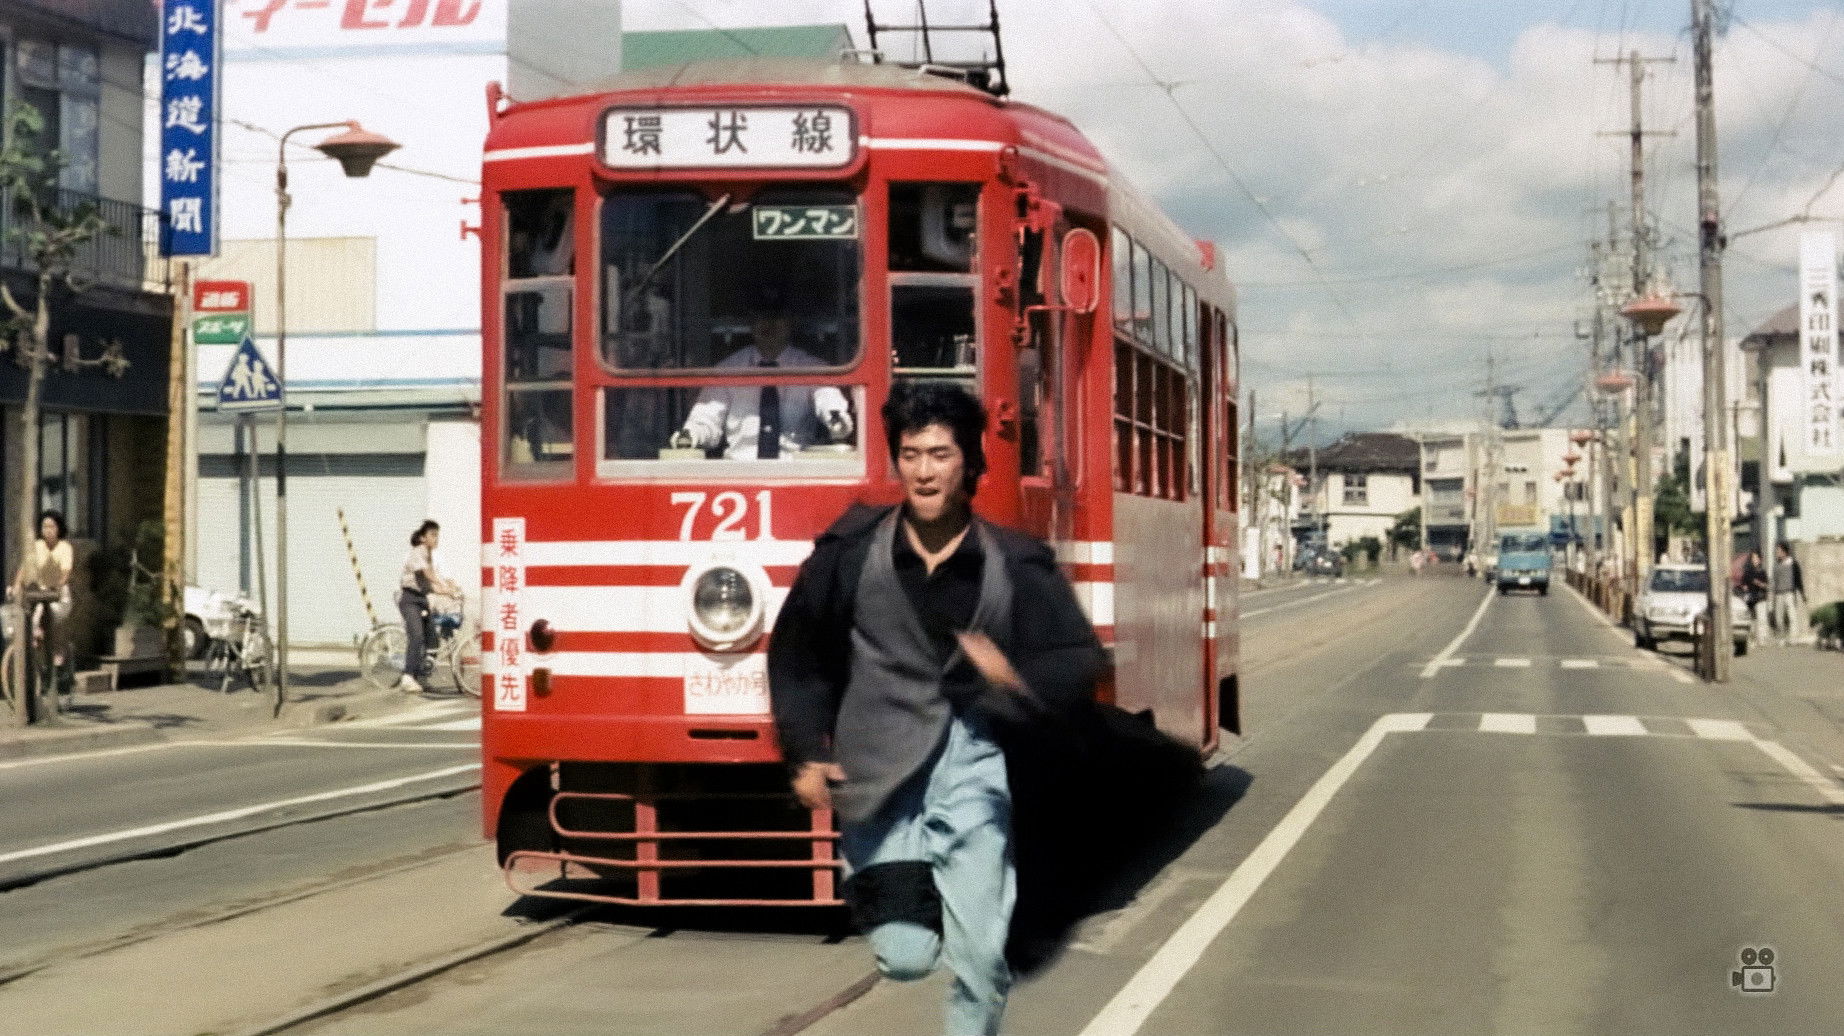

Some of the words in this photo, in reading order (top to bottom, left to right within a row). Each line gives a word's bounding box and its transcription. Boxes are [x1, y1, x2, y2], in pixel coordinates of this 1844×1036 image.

[166, 5, 208, 233] 北海道新聞
[623, 110, 833, 155] 環状線
[759, 209, 854, 235] ワンマン
[671, 490, 776, 541] 721
[500, 529, 519, 701] 乗降者優先
[689, 671, 767, 697] さわやか号
